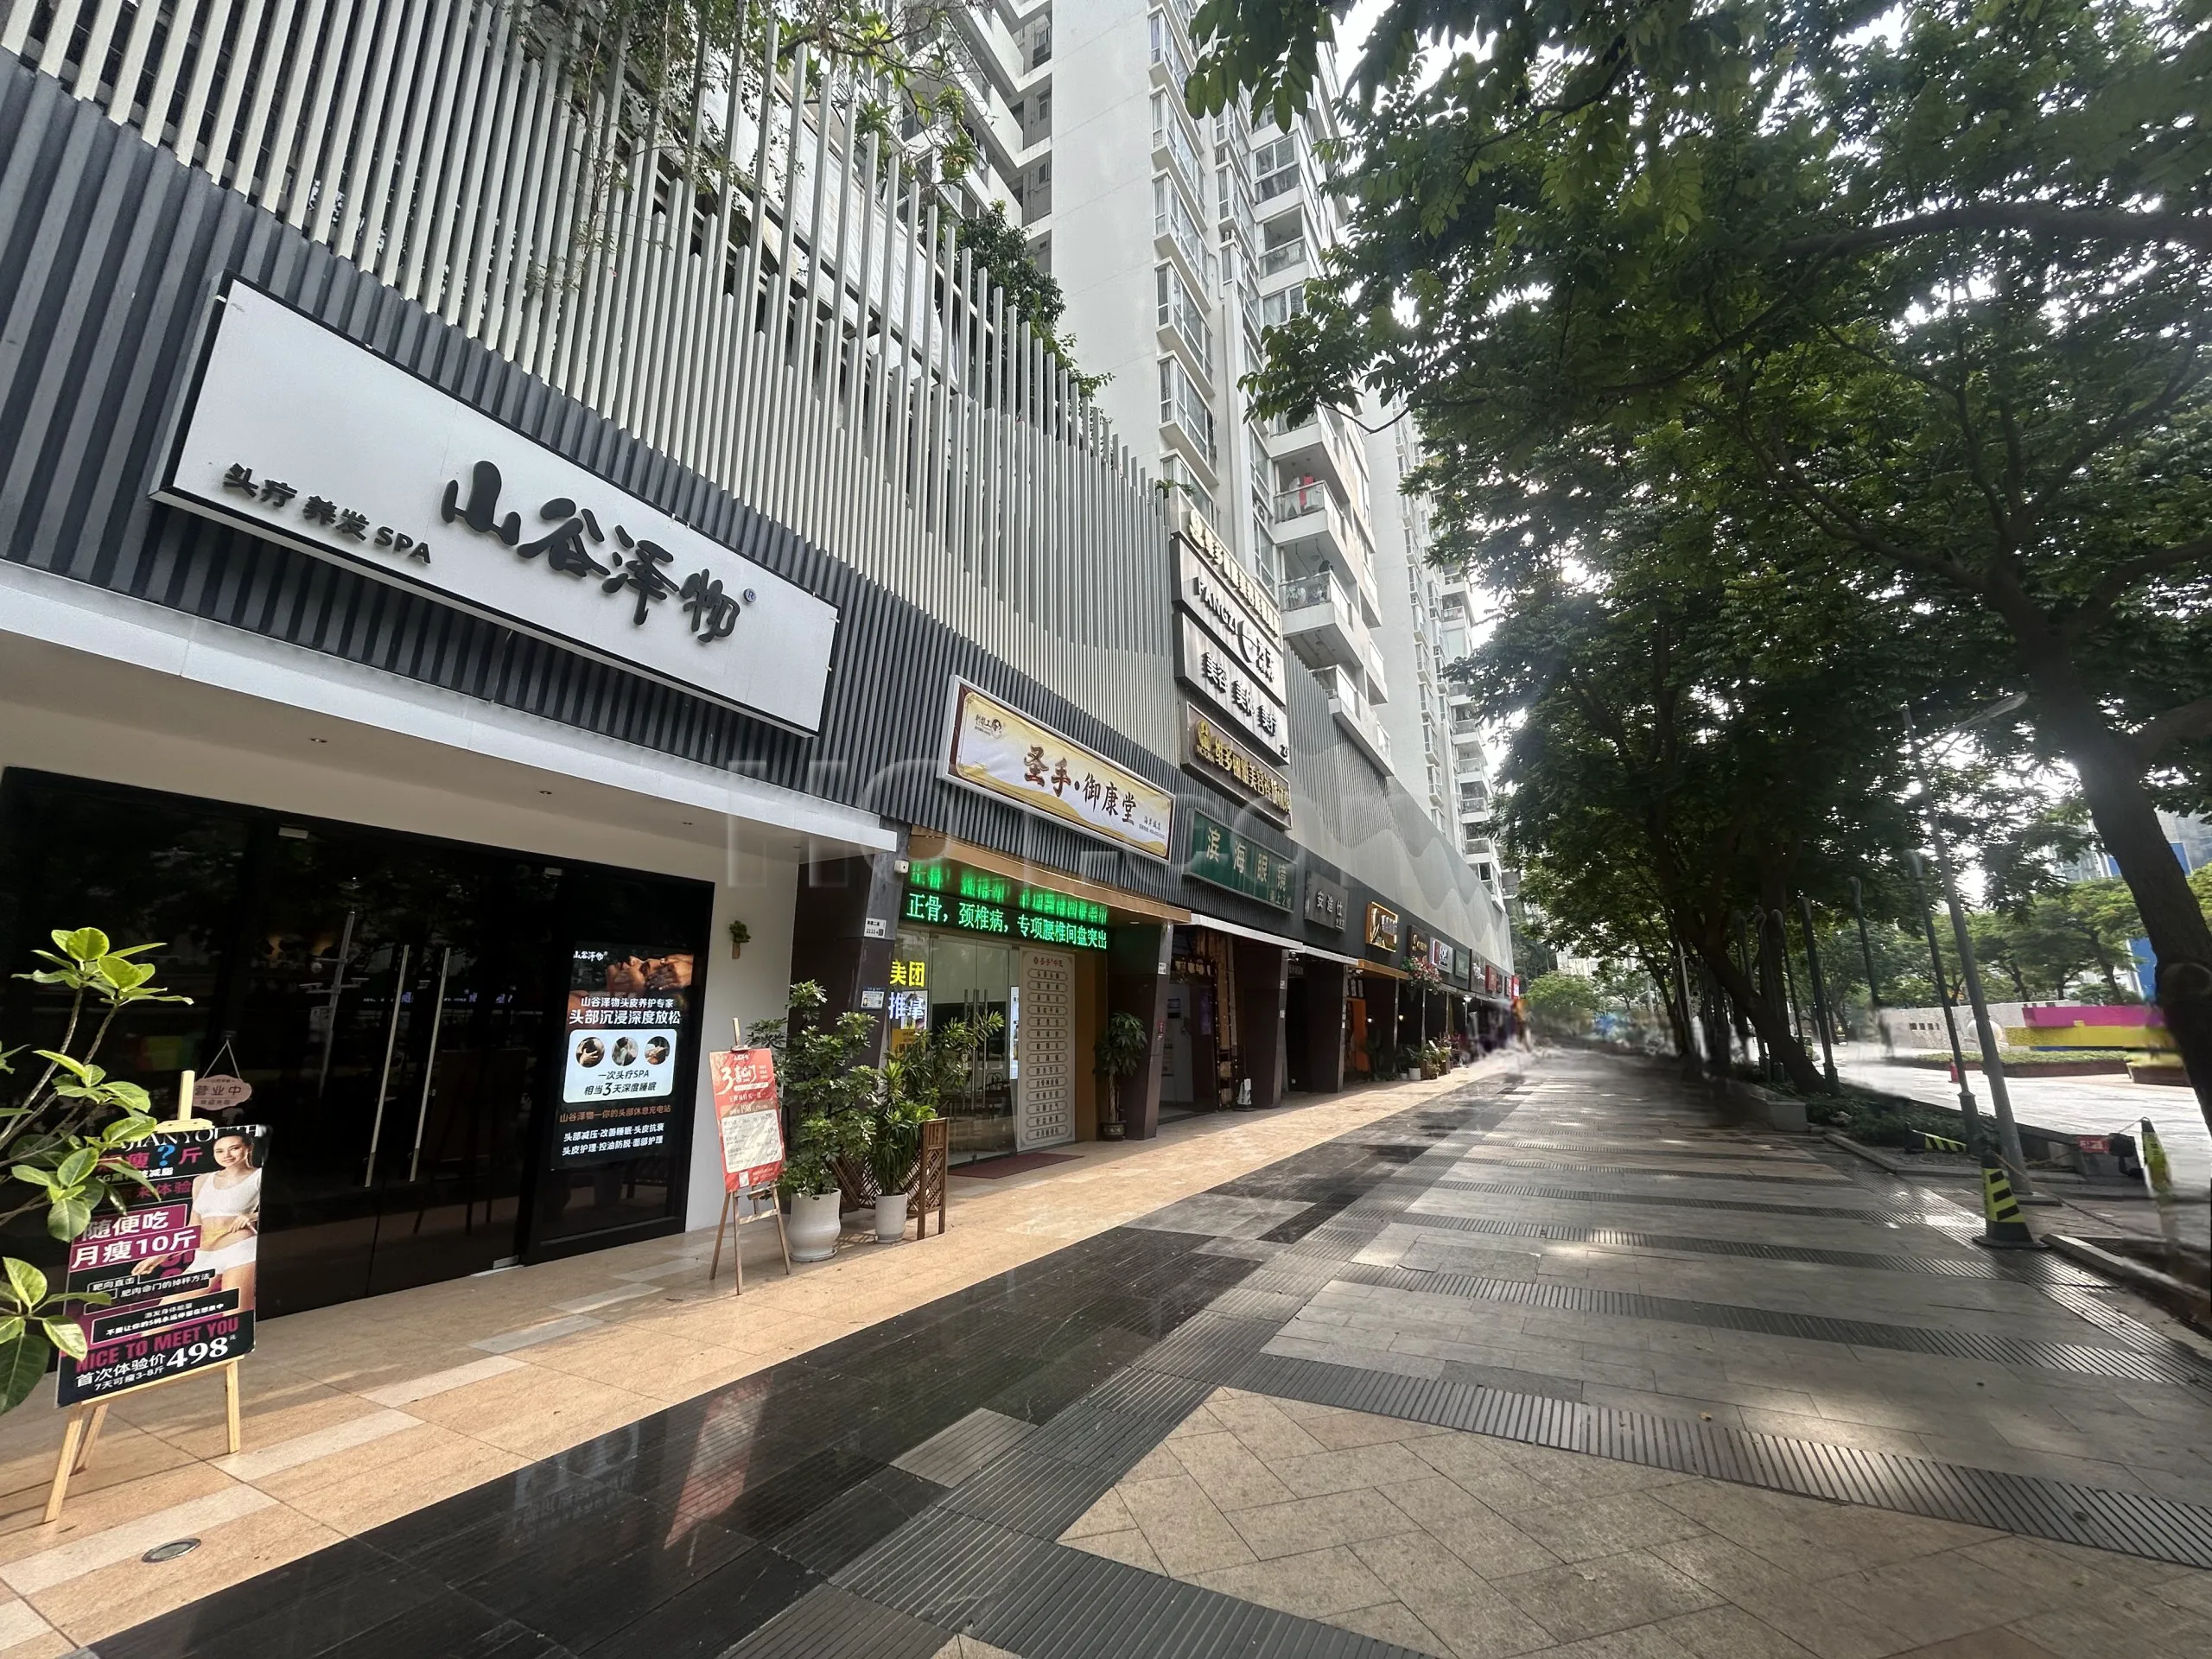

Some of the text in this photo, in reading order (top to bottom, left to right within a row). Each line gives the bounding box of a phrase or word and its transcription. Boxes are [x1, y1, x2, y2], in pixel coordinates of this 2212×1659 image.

[223, 463, 431, 564] 头疗 养发 SPA
[442, 460, 740, 645] 山谷泽物
[1206, 827, 1287, 891] 滨海眼镜
[890, 959, 925, 987] 美团
[581, 996, 674, 1008] 山谷泽物头皮养护专家
[888, 992, 925, 1020] 推拿
[569, 1009, 681, 1025] 头部沉浸深度放松
[584, 1081, 657, 1096] 相当3天深度睡眠
[598, 1070, 649, 1080] 一次头疗SPA
[195, 1085, 241, 1096] 营业中
[81, 1211, 169, 1242] 随便吃
[71, 1229, 196, 1268] 月瘦10斤
[126, 1338, 149, 1361] TO
[154, 1325, 203, 1353] MEET
[207, 1316, 239, 1338] YOU
[75, 1352, 165, 1388] 首次体验价
[95, 1365, 164, 1391] 7天可瘦3-8斤
